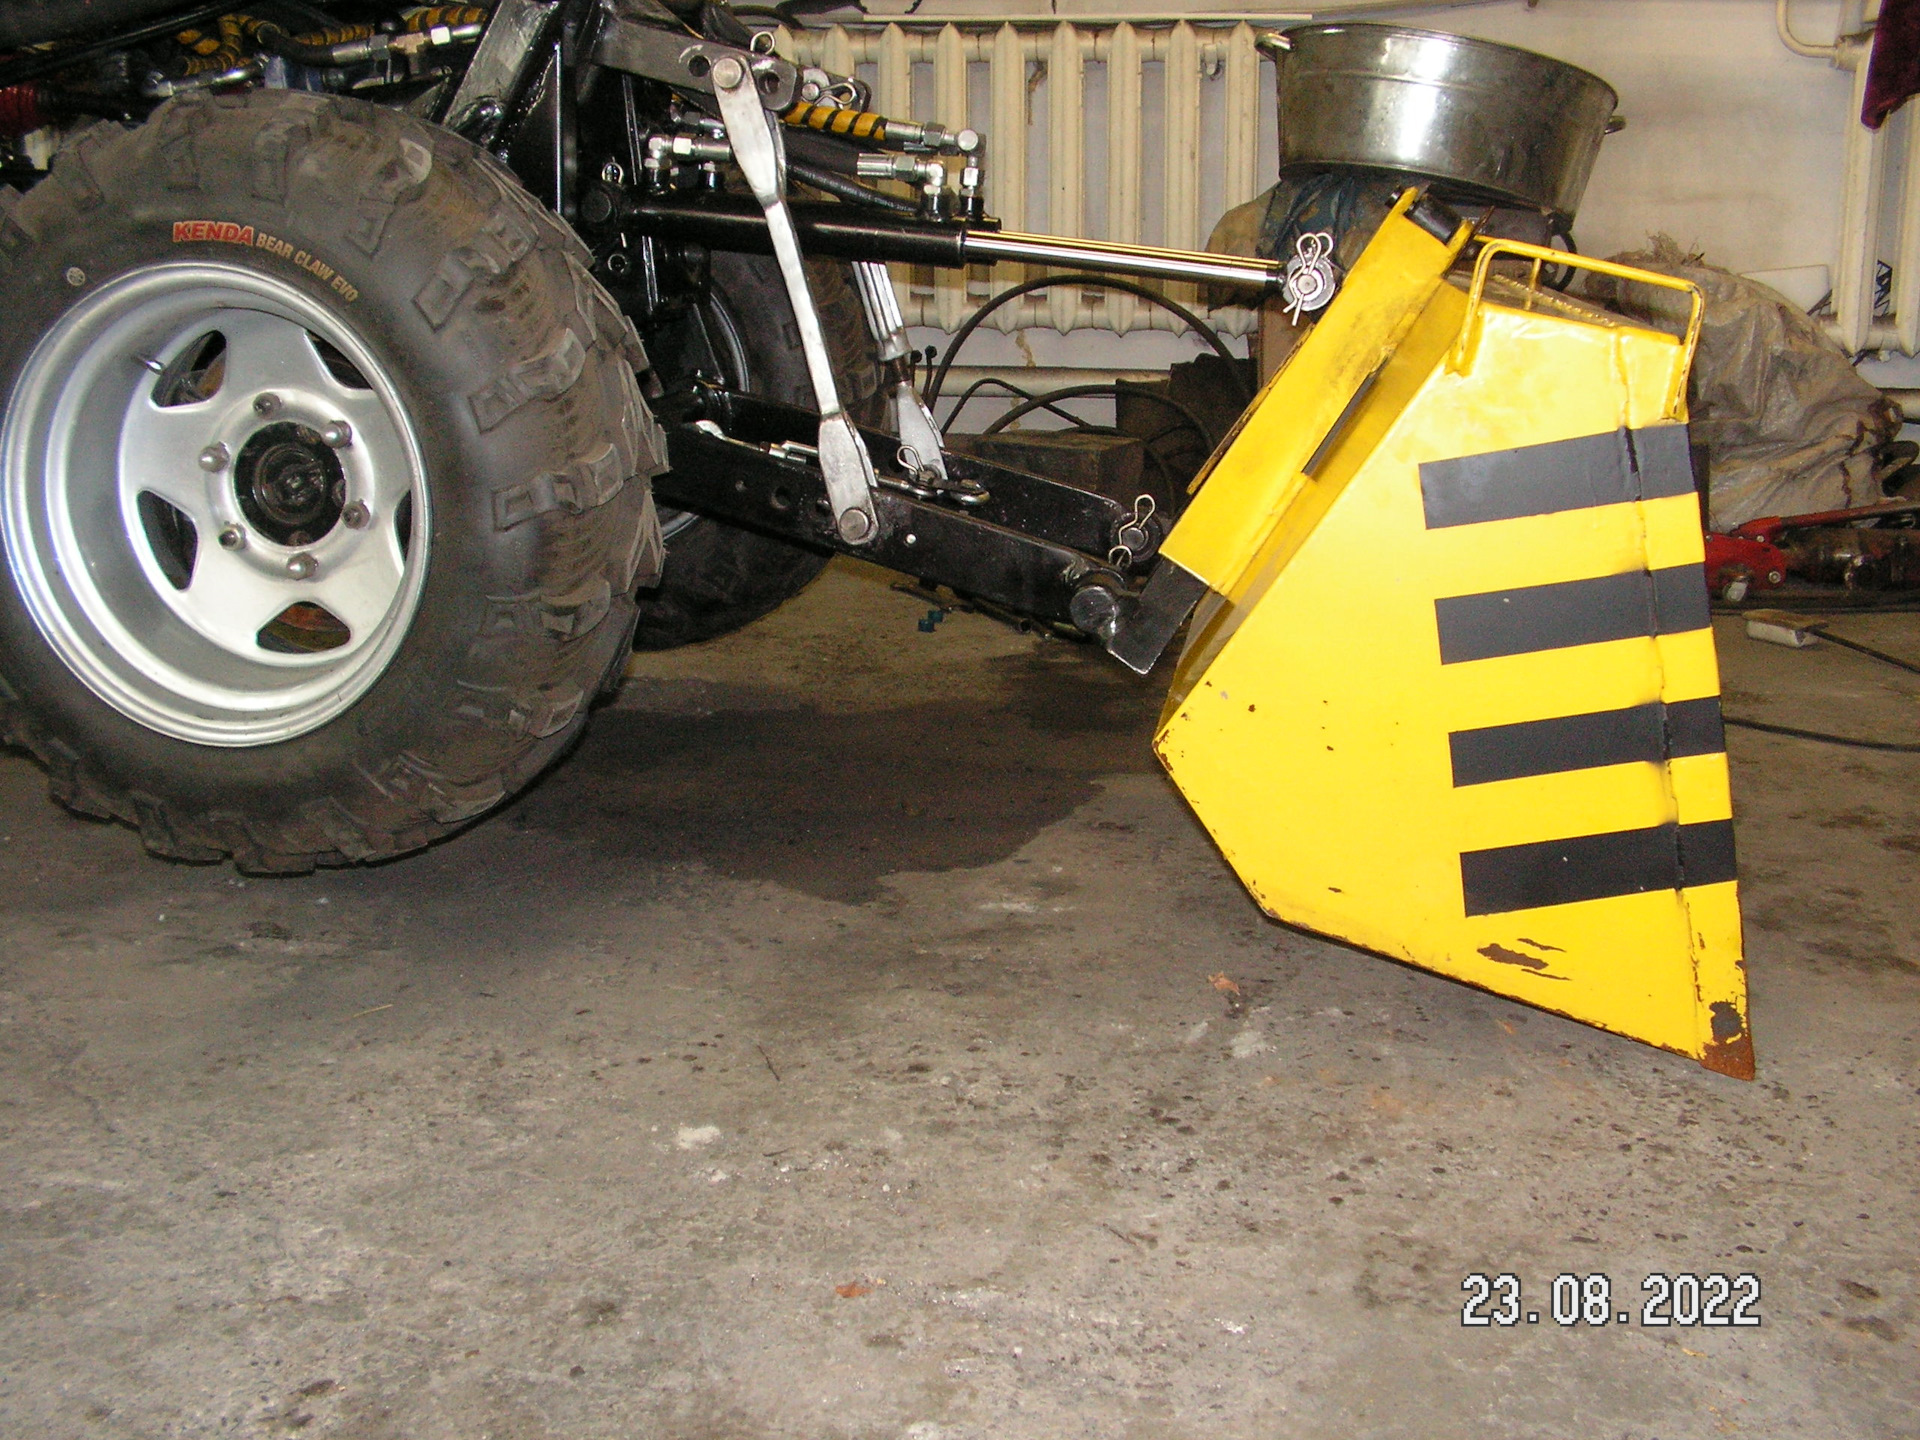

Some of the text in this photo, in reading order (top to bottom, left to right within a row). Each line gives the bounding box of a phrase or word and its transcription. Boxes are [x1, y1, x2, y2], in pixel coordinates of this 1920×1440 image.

[173, 221, 359, 302] KENDA BEAR CLAW EVO
